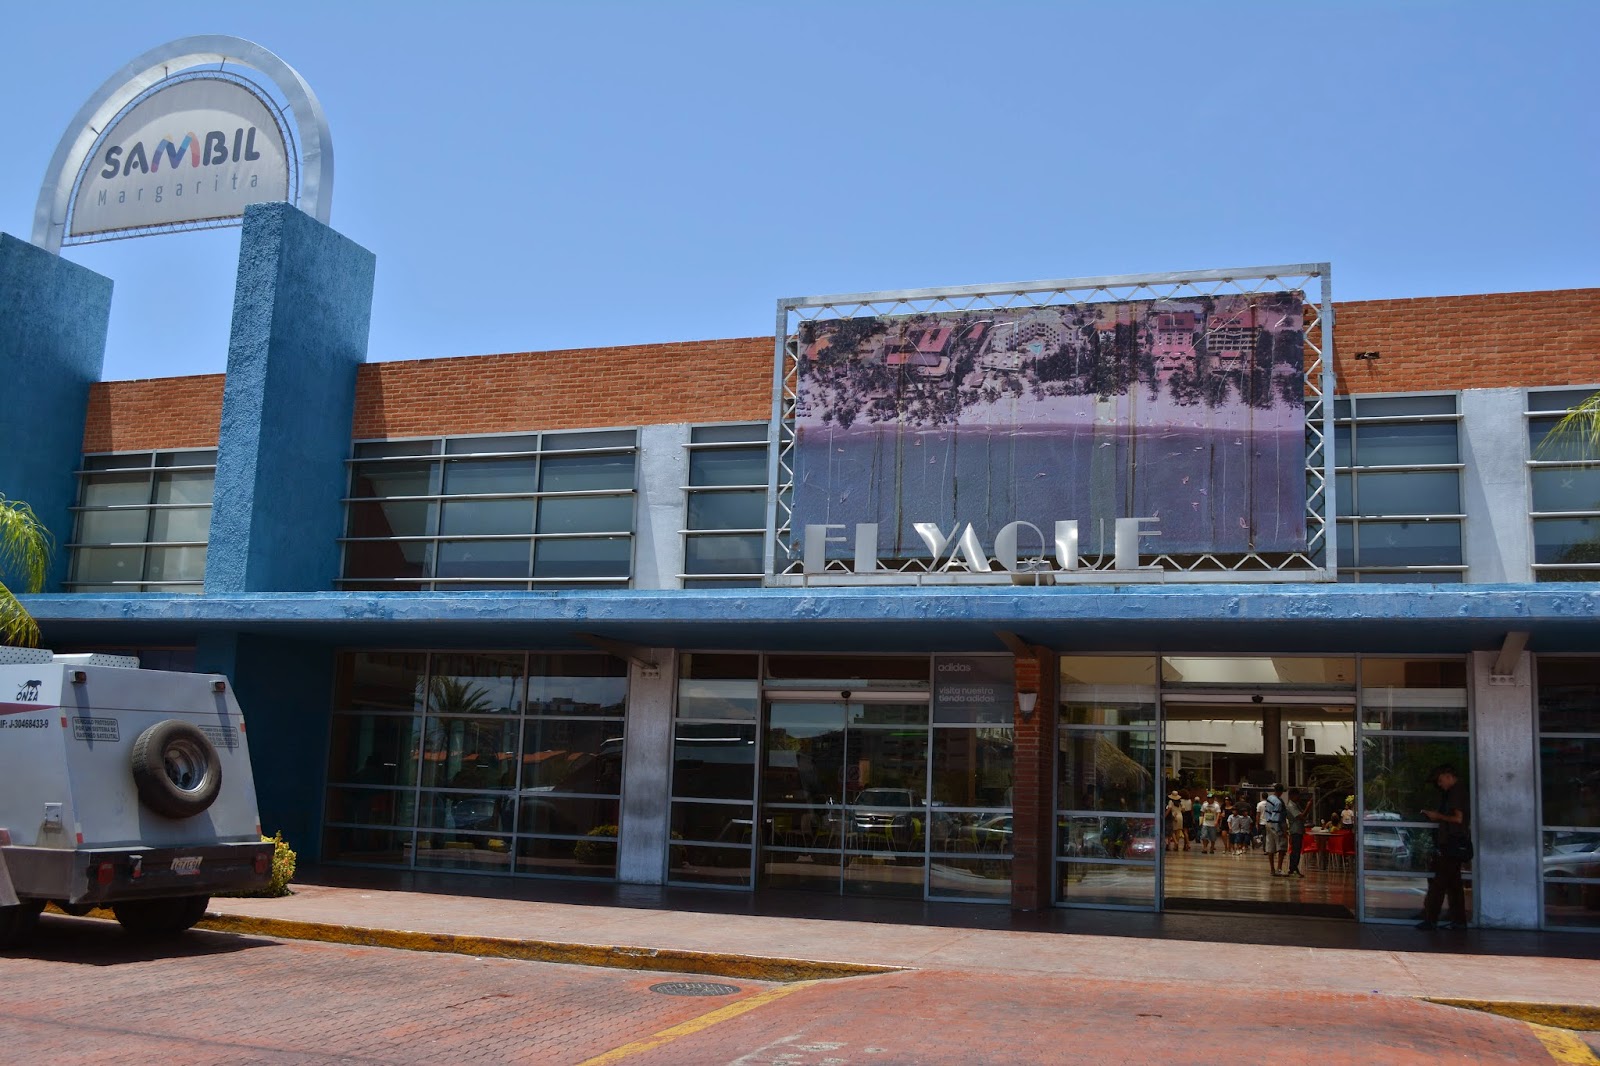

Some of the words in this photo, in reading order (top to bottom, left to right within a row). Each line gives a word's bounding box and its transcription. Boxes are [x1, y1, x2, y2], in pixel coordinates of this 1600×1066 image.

[101, 126, 261, 180] SAMBIL
[97, 172, 258, 206] Margarita
[803, 522, 898, 574] EL
[912, 517, 1164, 573] YAQUE
[937, 662, 971, 672] adidas
[16, 690, 39, 702] ONZA
[939, 686, 960, 695] visita
[961, 686, 994, 695] nuestra
[938, 694, 965, 702] tienda
[966, 694, 995, 702] adidas
